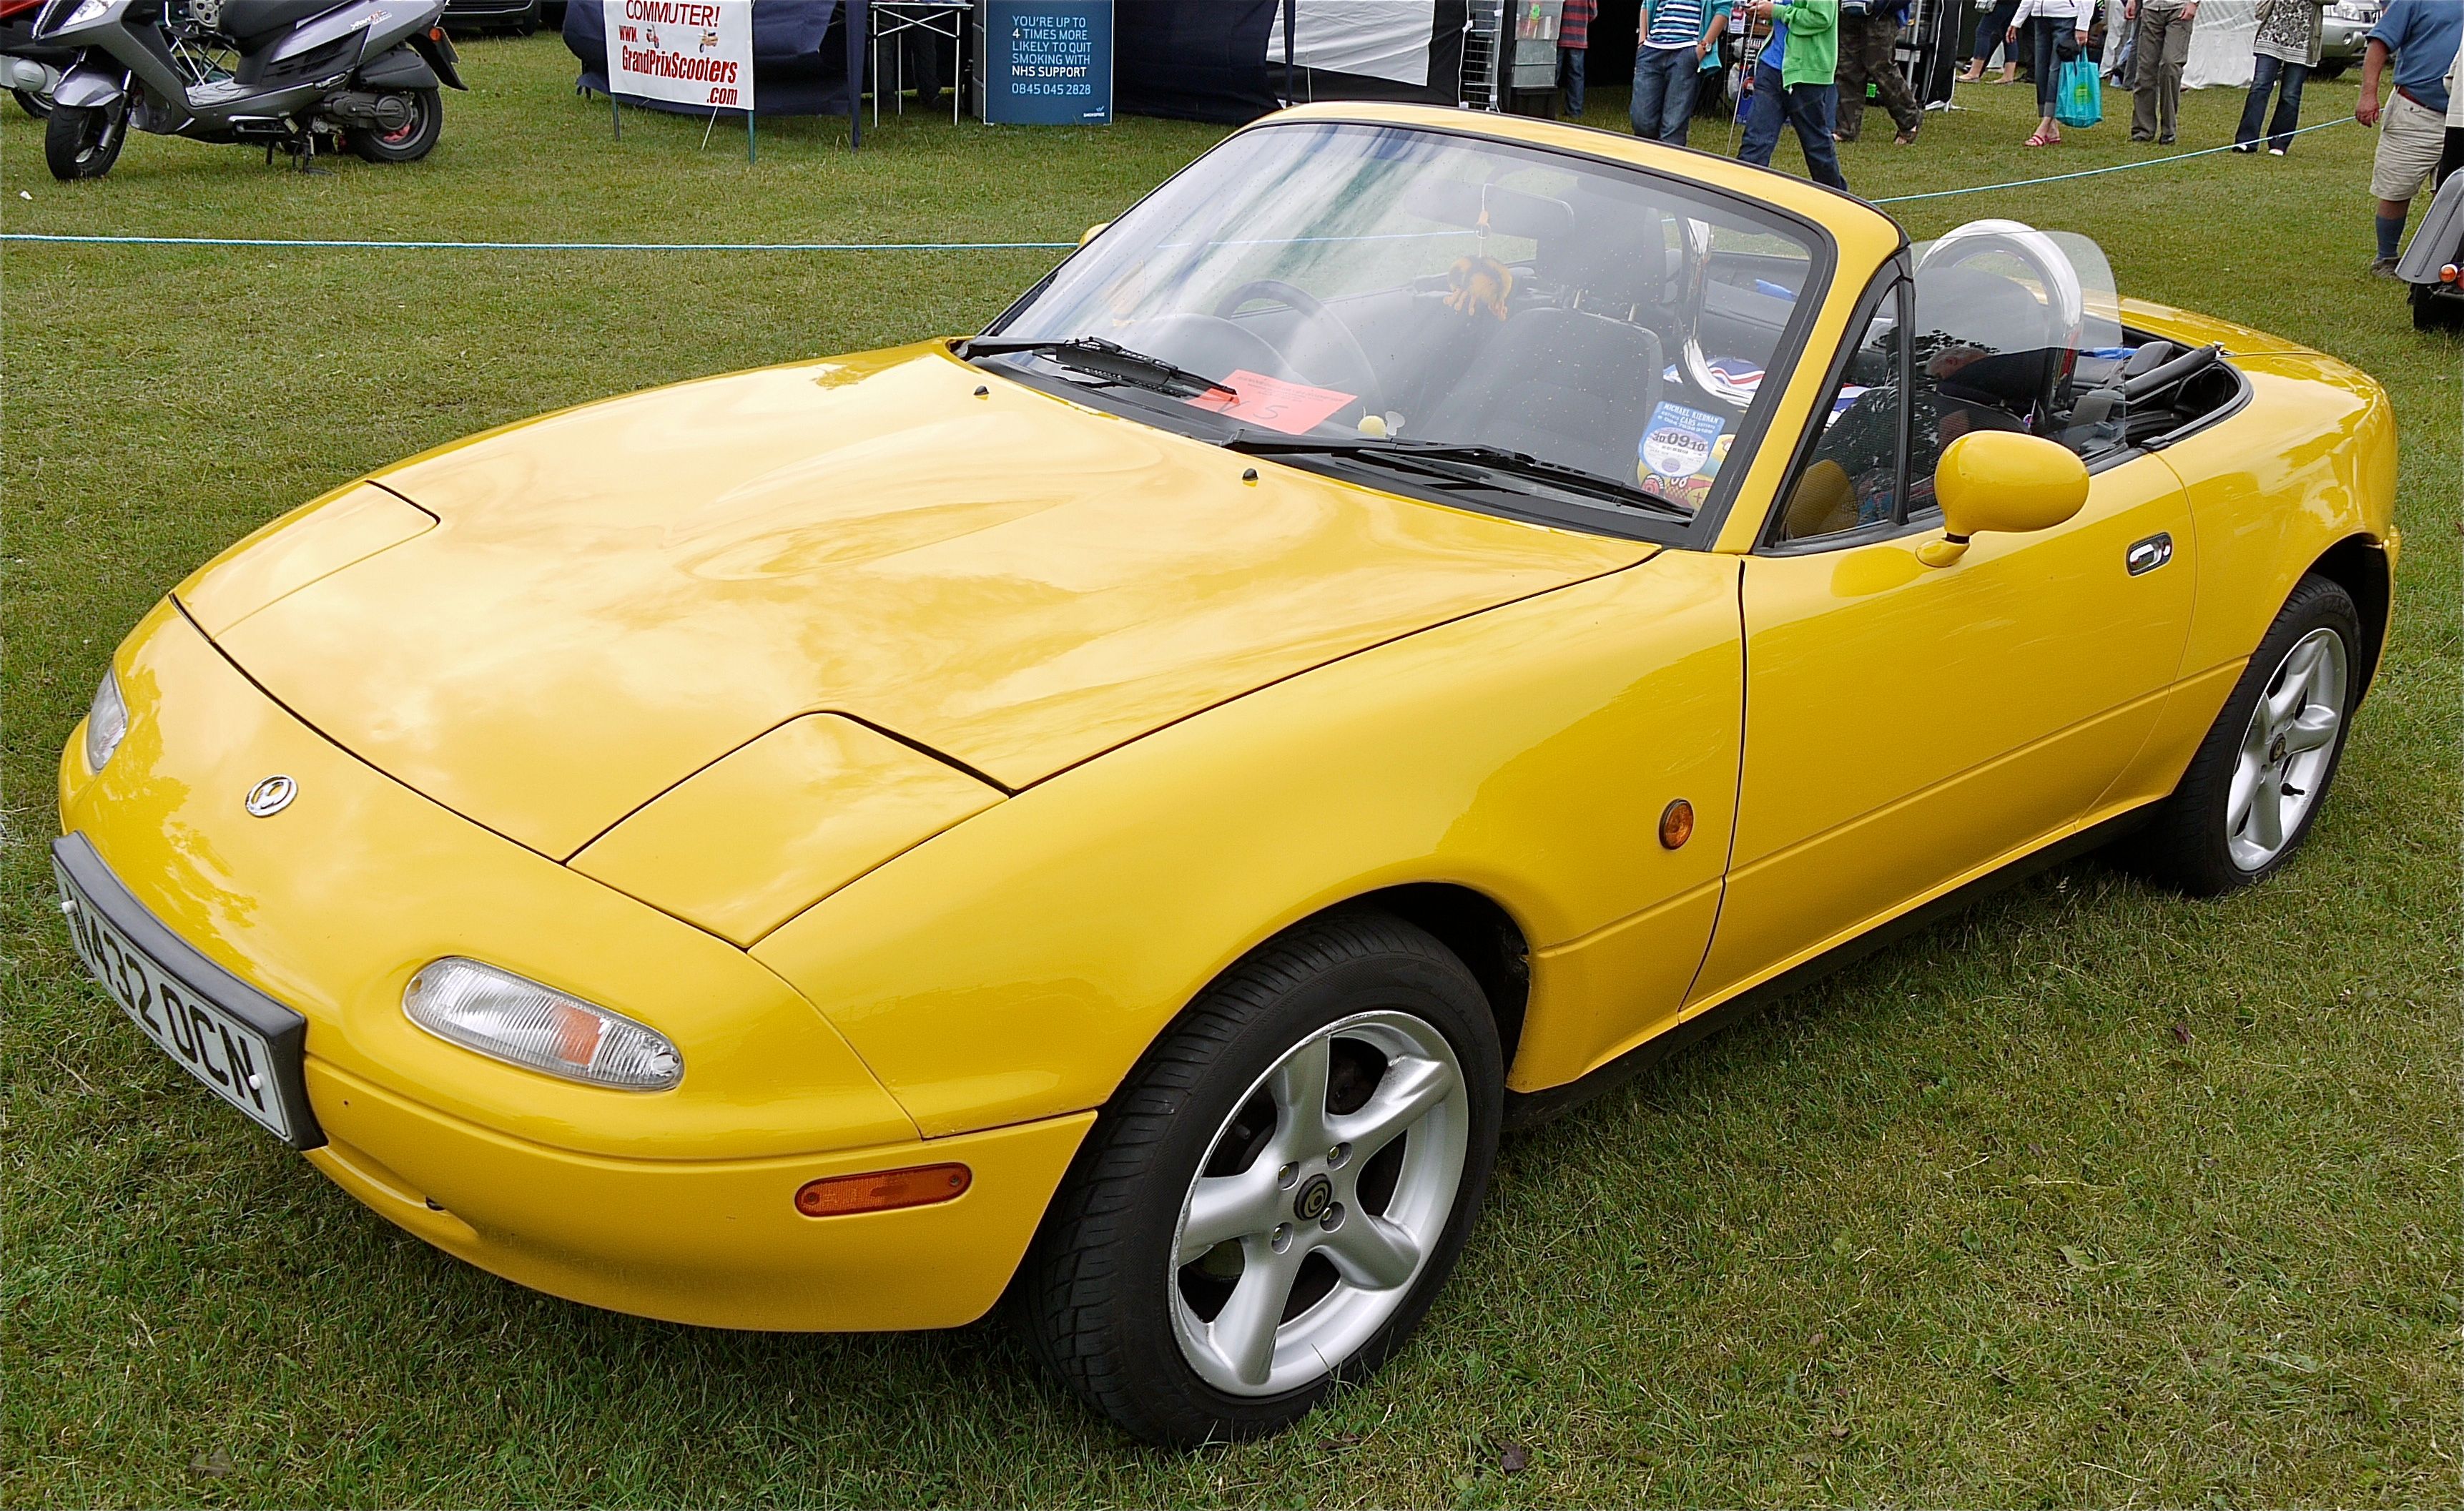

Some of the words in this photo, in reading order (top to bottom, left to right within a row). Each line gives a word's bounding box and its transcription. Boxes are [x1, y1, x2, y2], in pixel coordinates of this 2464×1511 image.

[626, 0, 721, 27] COMMUTER!
[1012, 16, 1053, 27] YOU'RE
[1056, 16, 1070, 27] UP
[1073, 17, 1085, 27] TO
[1012, 28, 1020, 39] 4
[1023, 29, 1056, 39] TIMES
[1059, 30, 1088, 40] MORE
[1012, 41, 1049, 52] LIKELY
[1053, 42, 1067, 52] TO
[1069, 42, 1092, 53] QUIT
[622, 45, 738, 84] GrandPrixScooters
[1012, 53, 1063, 64] SMOKING
[1065, 54, 1090, 65] WITH
[1012, 66, 1035, 77] NHS
[1038, 67, 1087, 77] SUPPORT
[1012, 83, 1040, 94] 0845
[1043, 84, 1064, 94] 045
[1066, 84, 1090, 94] 2828
[706, 87, 738, 106] .com
[1663, 403, 1690, 416] MICHAEL
[1692, 411, 1719, 423] KIERNAN
[1680, 417, 1695, 426] CARS
[1667, 433, 1690, 447] 09
[1690, 441, 1705, 452] 10
[159, 983, 266, 1113] OCN
